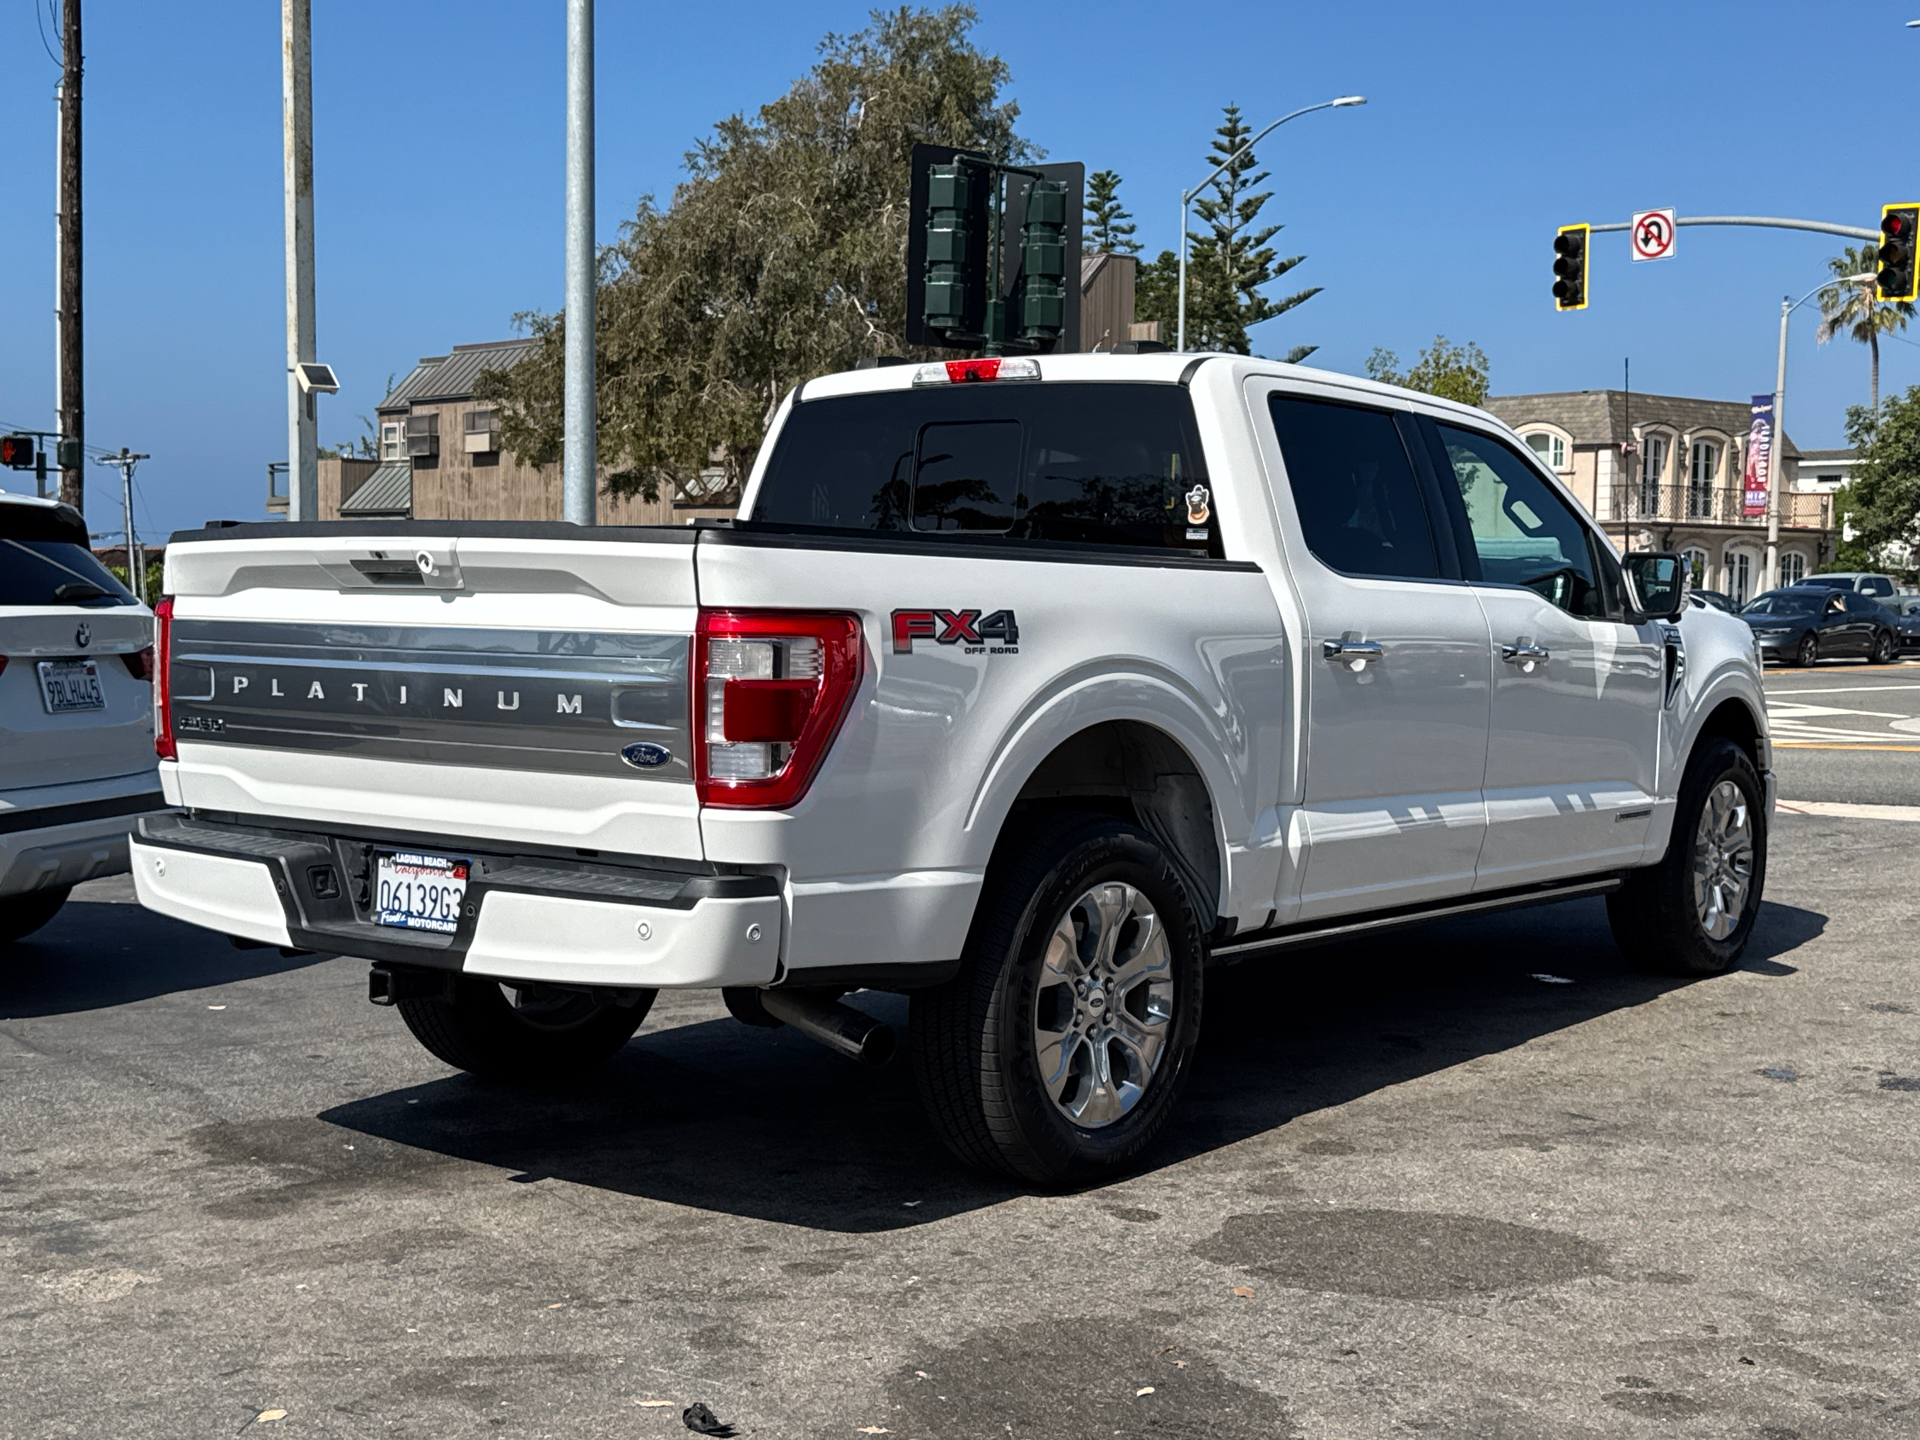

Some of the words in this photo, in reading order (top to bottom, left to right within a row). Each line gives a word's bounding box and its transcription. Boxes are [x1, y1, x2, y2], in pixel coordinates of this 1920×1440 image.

[890, 608, 1020, 656] FX4
[964, 647, 986, 655] OFF
[990, 647, 1019, 655] ROAD
[47, 679, 101, 704] 9BLH445
[232, 676, 583, 714] PLATINUM
[631, 747, 660, 764] Ford
[396, 853, 423, 865] LAGUNA
[424, 856, 447, 868] BEACH
